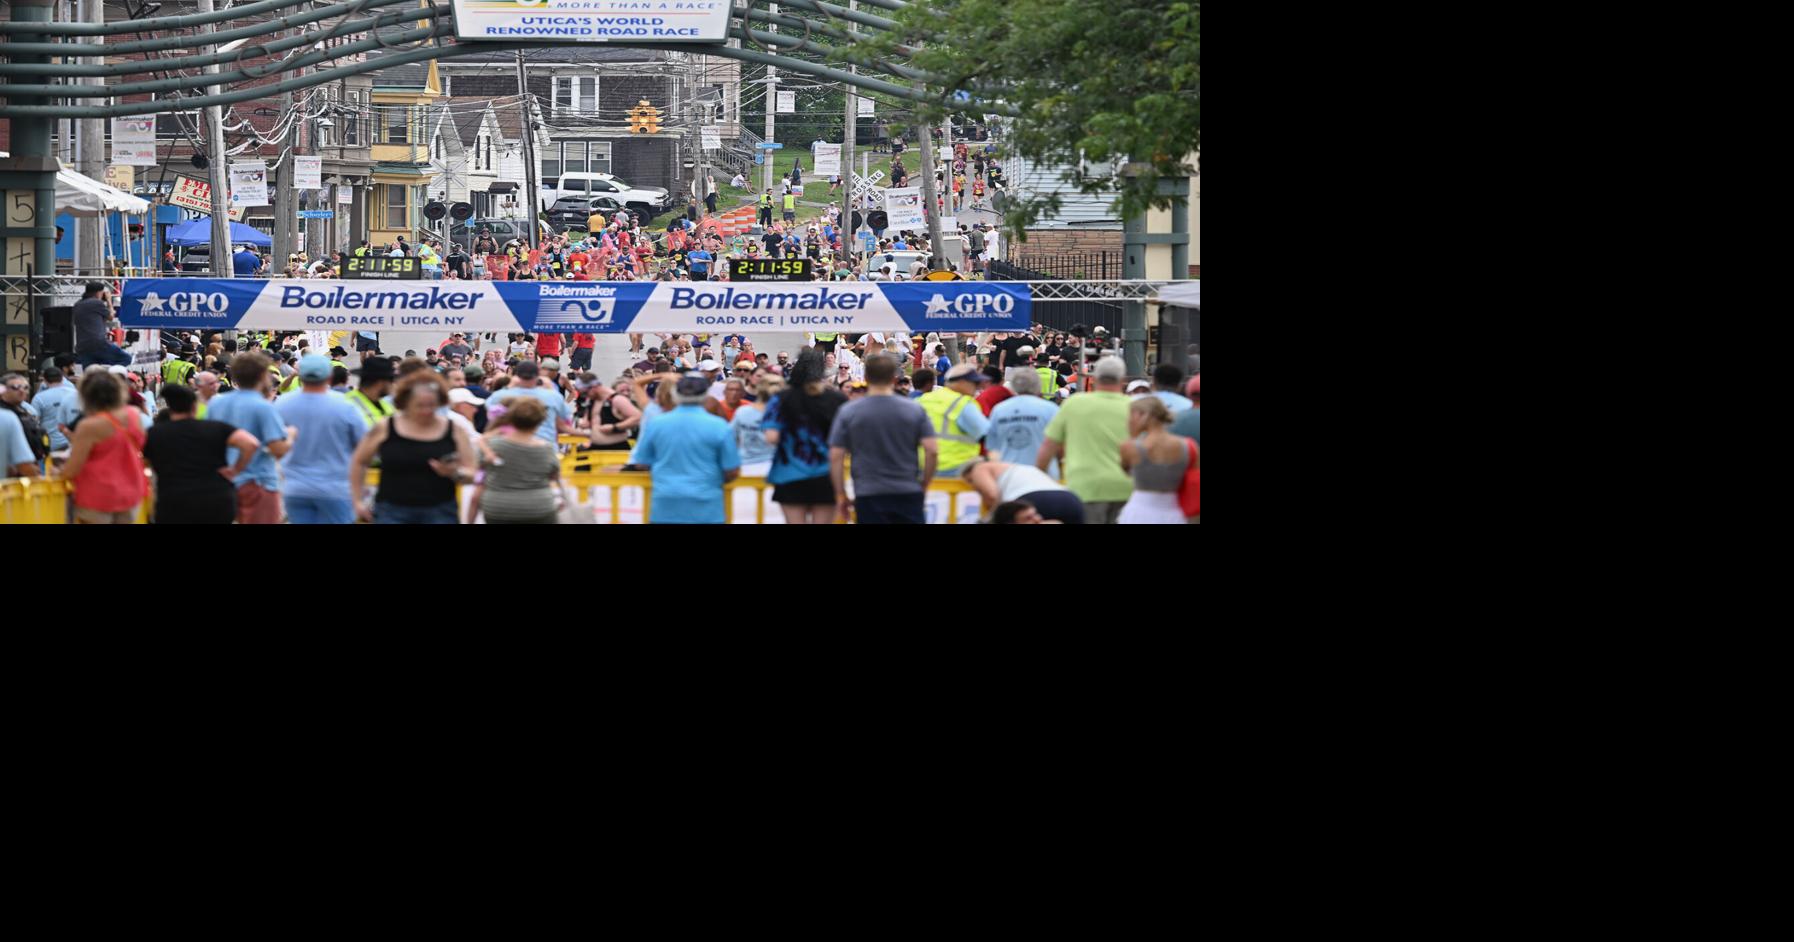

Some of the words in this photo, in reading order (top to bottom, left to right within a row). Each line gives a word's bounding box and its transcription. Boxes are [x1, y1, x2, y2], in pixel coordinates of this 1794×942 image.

[520, 17, 592, 26] UTICA'S
[596, 17, 664, 26] WORLD
[485, 26, 593, 36] RENOWNED
[597, 27, 648, 36] ROAD
[653, 28, 700, 36] RACE
[852, 171, 882, 199] ROSSING
[866, 187, 883, 202] ROAD
[280, 286, 483, 310] Boilermaker
[539, 285, 617, 297] Boilermaker
[670, 287, 873, 310] Boilermaker
[168, 292, 229, 313] GPO
[954, 293, 1014, 313] GPO
[306, 315, 346, 325] ROAD
[351, 316, 384, 325] RACE
[401, 316, 440, 325] UTICA
[444, 316, 465, 325] NY
[696, 316, 736, 325] ROAD
[740, 316, 774, 325] RACE
[790, 316, 829, 325] UTICA
[834, 316, 854, 325] NY
